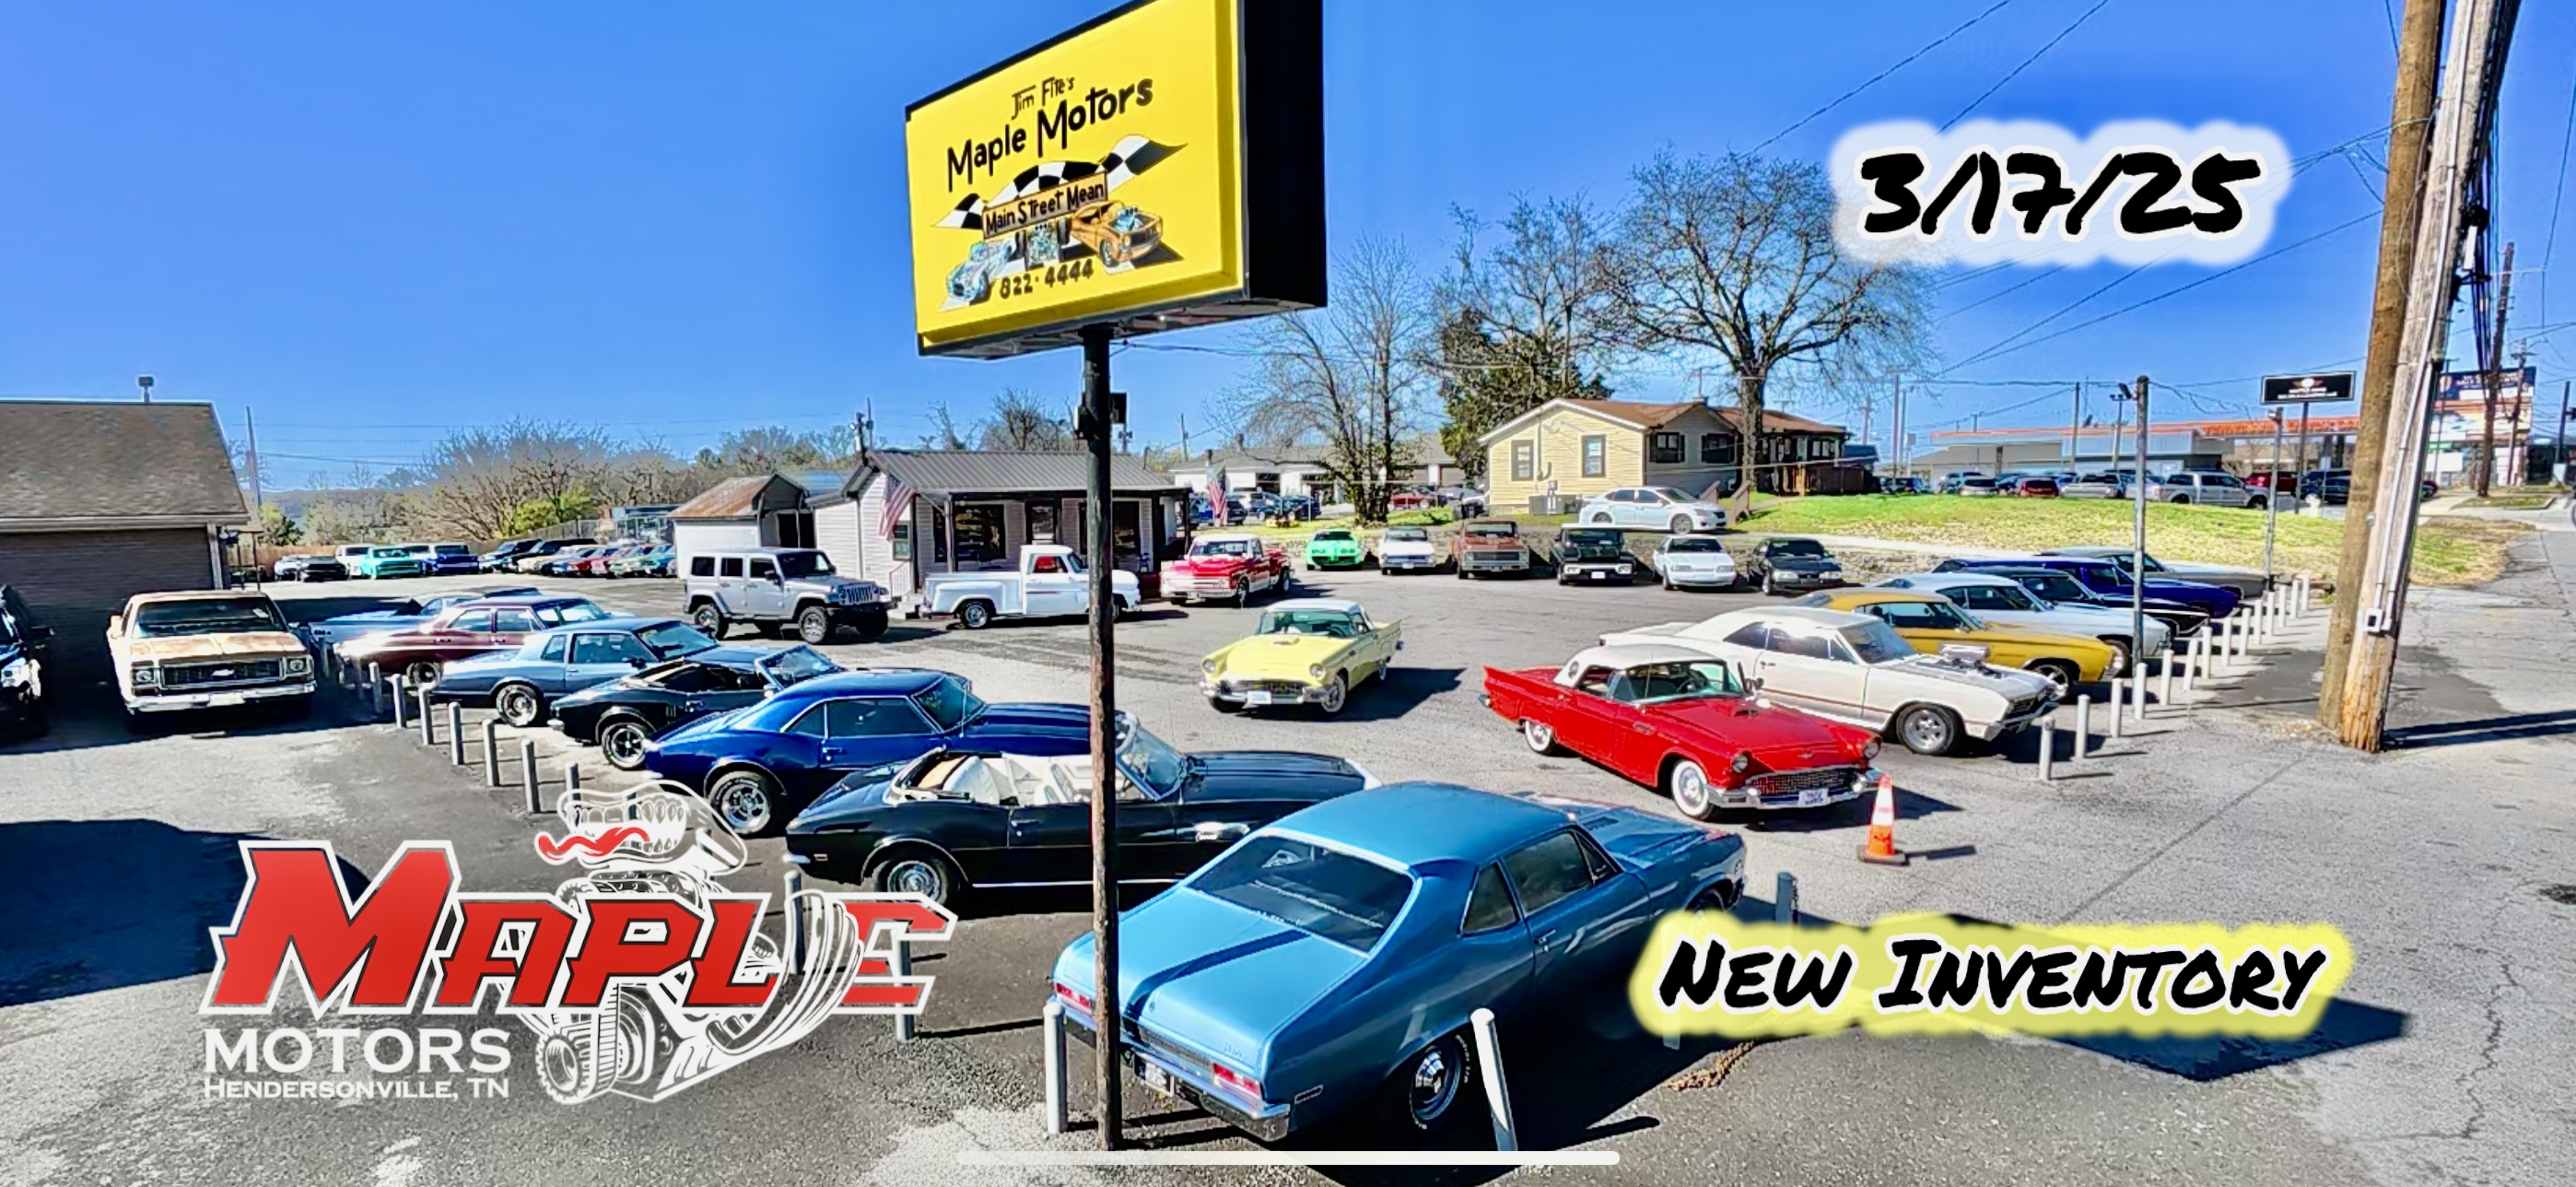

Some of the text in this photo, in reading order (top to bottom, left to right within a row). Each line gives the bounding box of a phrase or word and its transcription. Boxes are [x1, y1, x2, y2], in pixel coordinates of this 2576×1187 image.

[1012, 85, 1036, 120] Jim
[947, 78, 1153, 192] Maple Motors
[986, 183, 1105, 235] Main Street Mean
